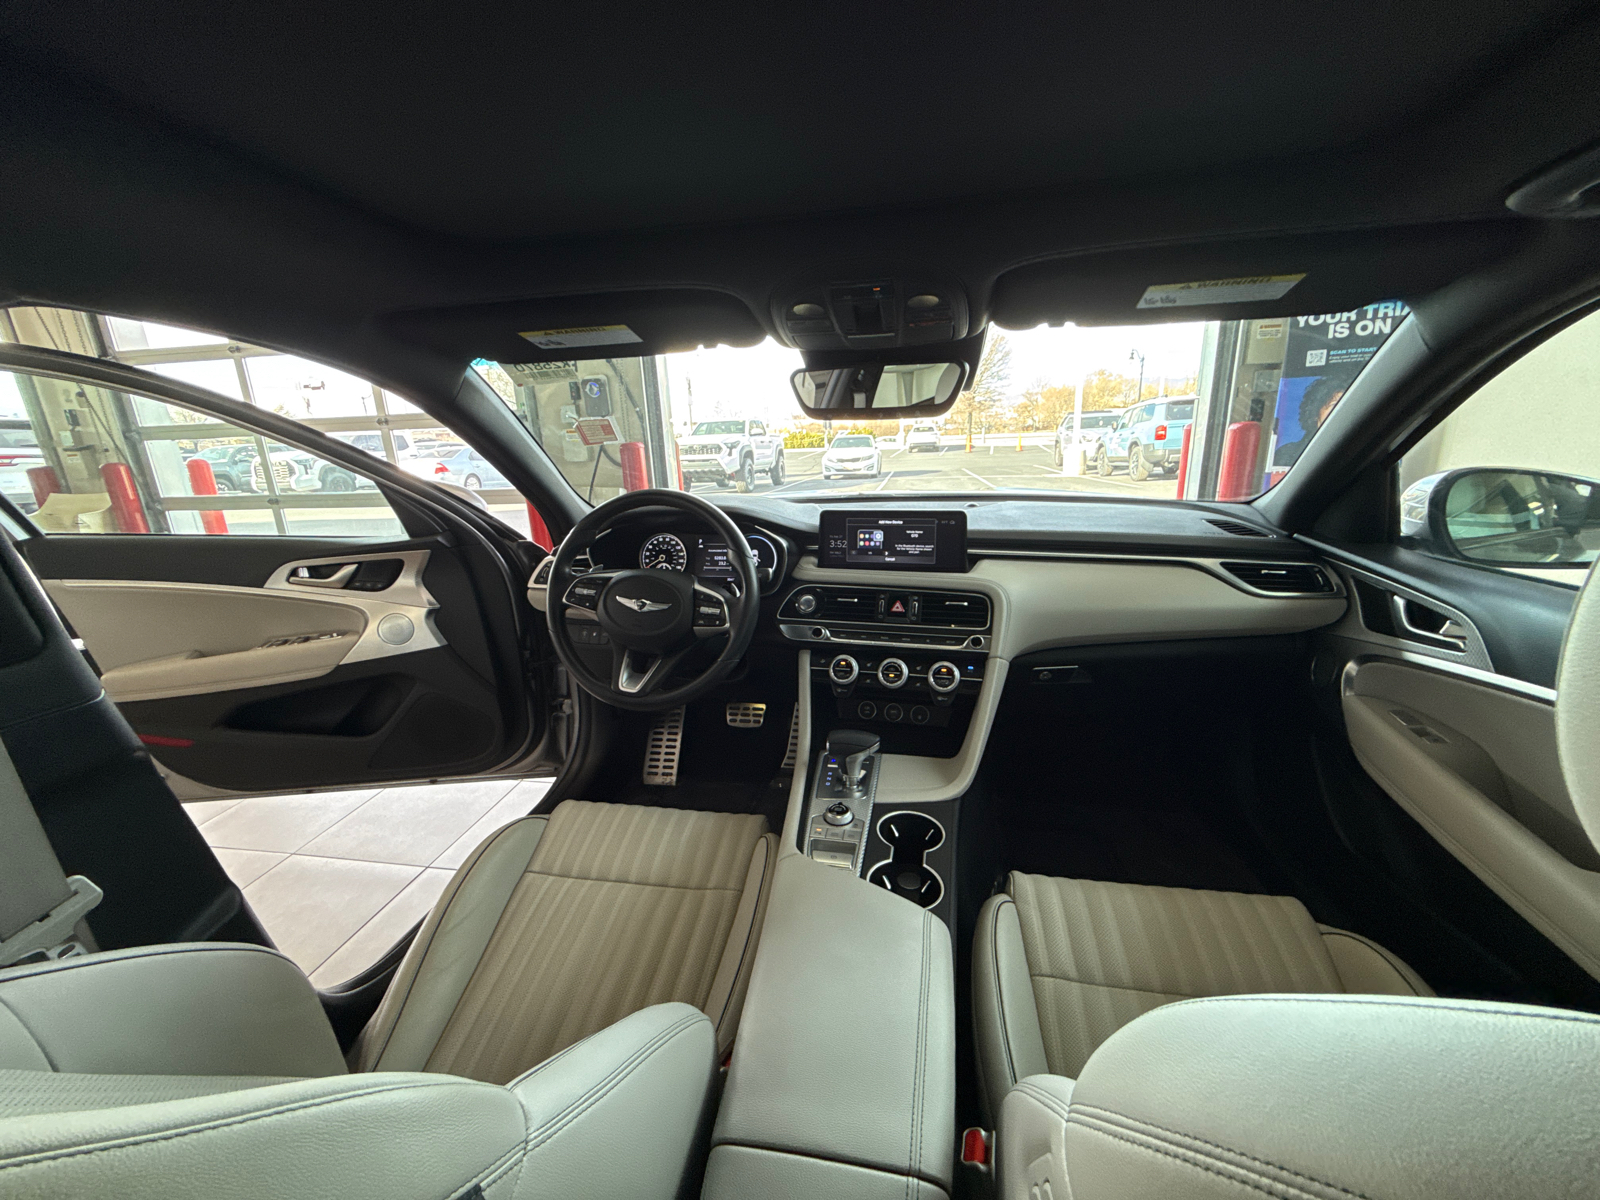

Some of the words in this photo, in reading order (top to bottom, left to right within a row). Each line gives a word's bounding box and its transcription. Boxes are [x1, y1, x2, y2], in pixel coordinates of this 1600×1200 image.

[1327, 322, 1350, 339] IS
[1354, 317, 1392, 336] ON
[829, 540, 847, 548] 3:52
